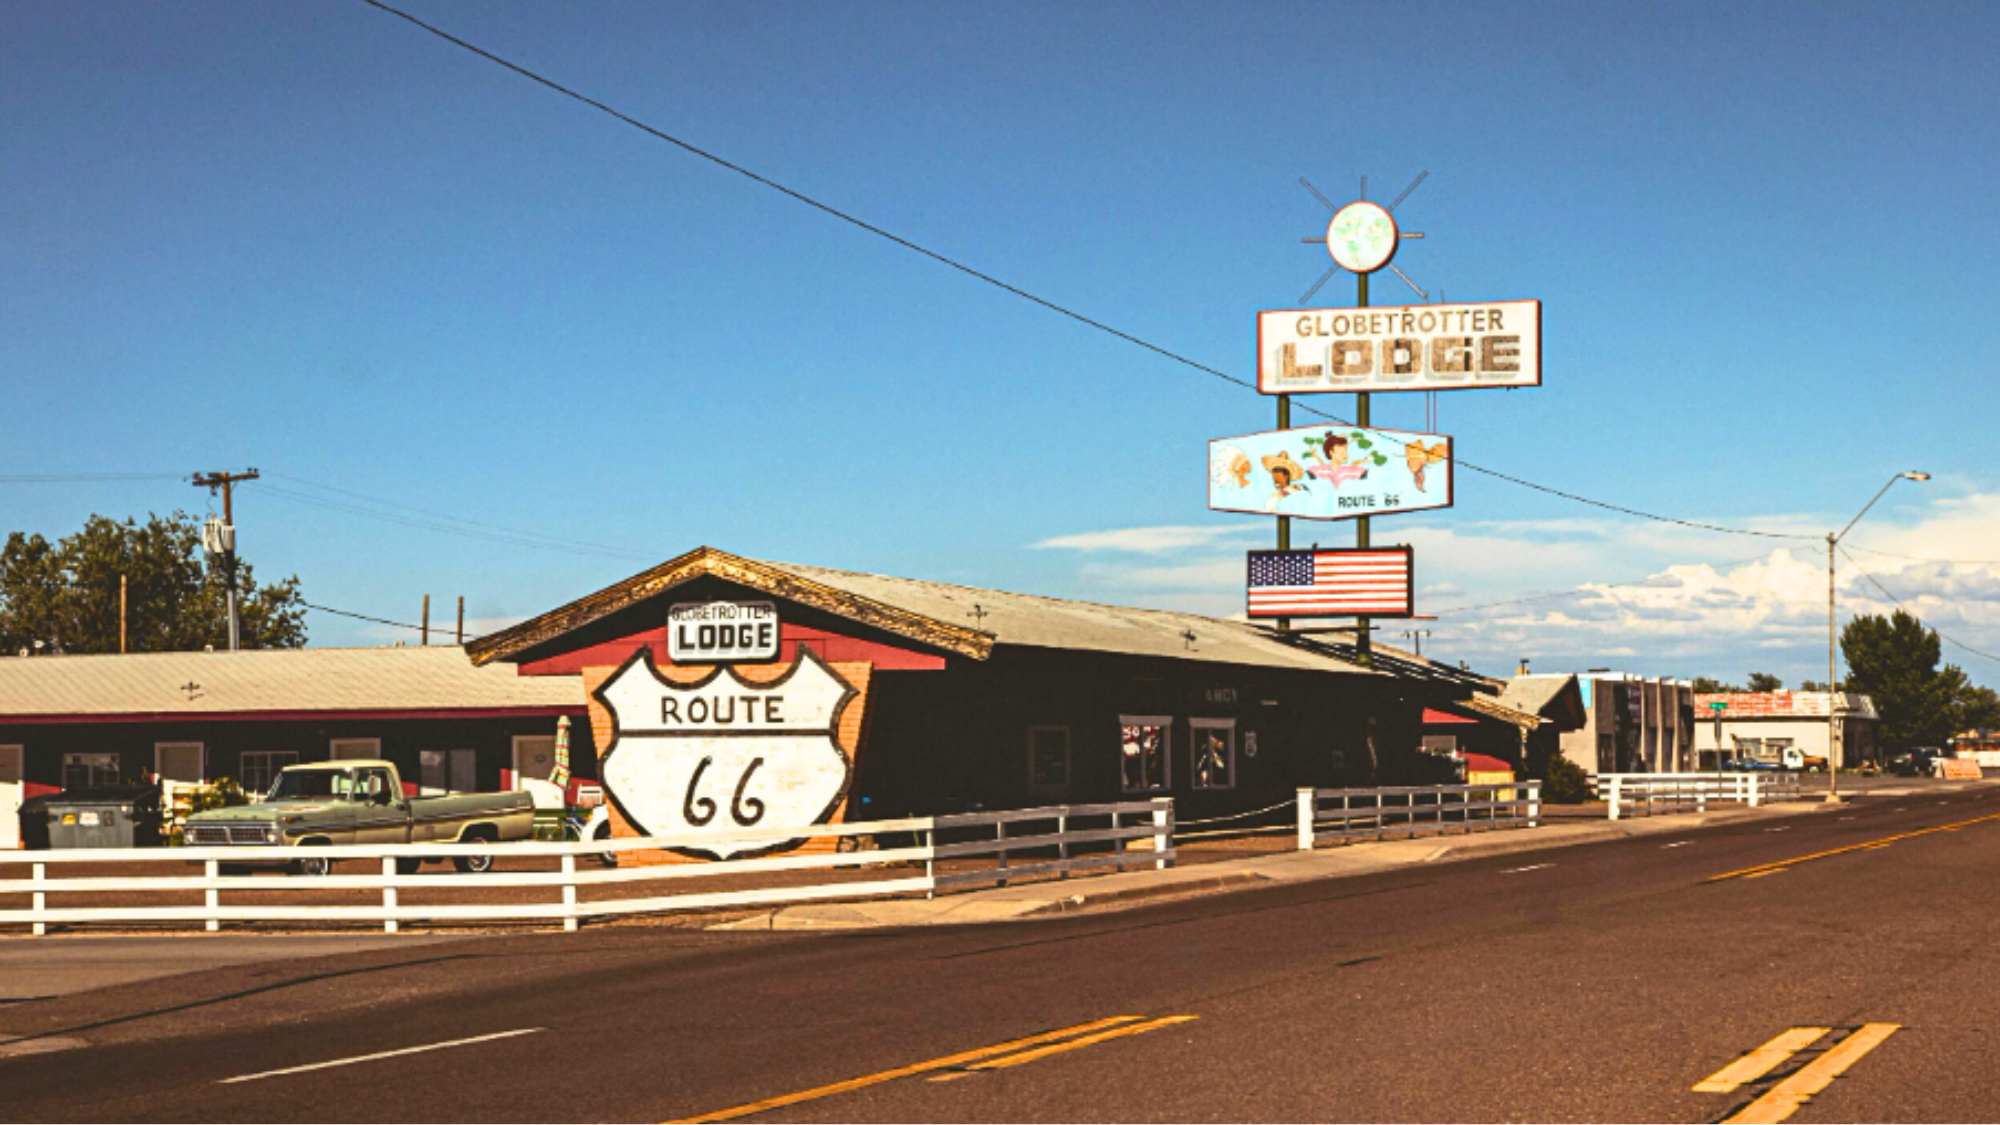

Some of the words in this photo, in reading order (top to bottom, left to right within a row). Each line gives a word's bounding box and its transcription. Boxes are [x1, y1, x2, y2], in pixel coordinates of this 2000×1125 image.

[1296, 309, 1504, 337] GLOBETROTTER
[1280, 335, 1521, 380] LODGE
[1338, 495, 1376, 508] ROUTE
[671, 604, 771, 621] GLOBETROTTER
[678, 623, 773, 650] LODGE
[661, 695, 785, 725] ROUTE
[682, 754, 766, 827] 66
